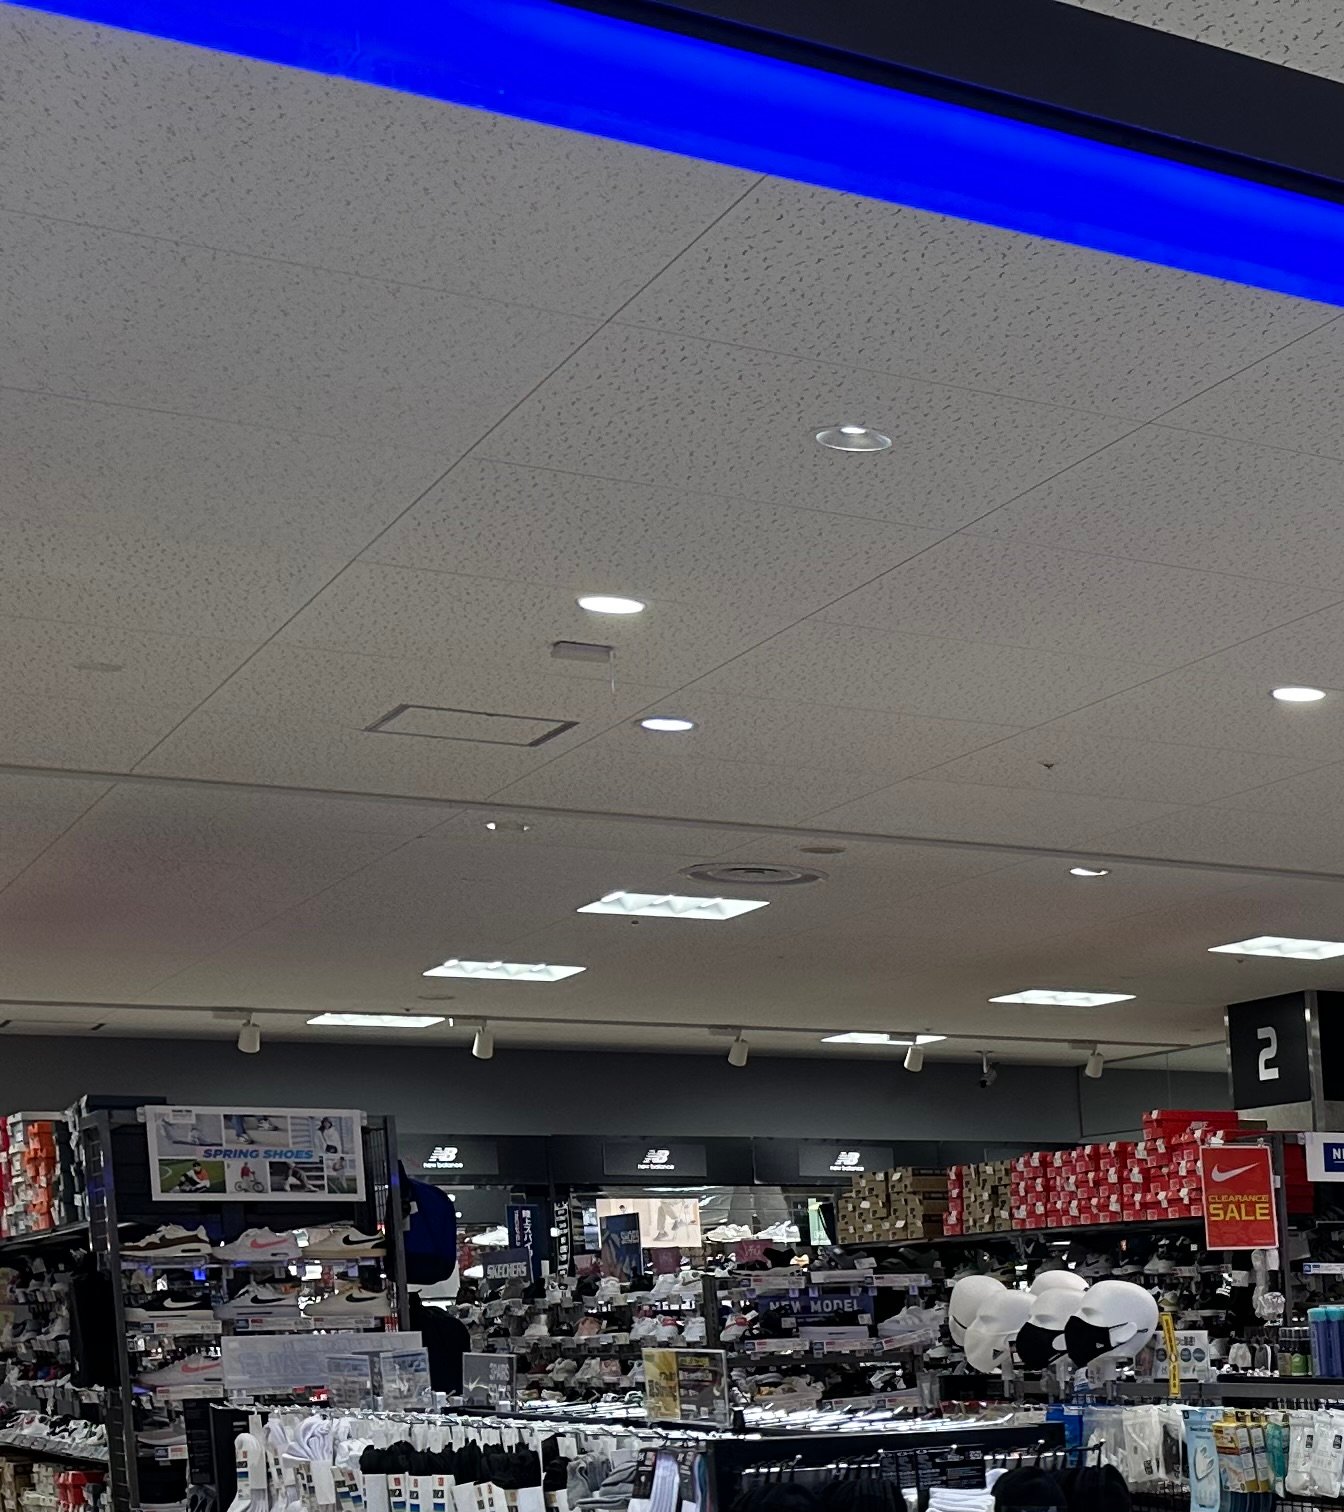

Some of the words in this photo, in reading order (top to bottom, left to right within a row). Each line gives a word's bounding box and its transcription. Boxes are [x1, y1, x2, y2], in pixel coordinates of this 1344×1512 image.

[1256, 1027, 1279, 1080] 2
[203, 1148, 260, 1159] SPRING
[262, 1149, 313, 1160] SHOES
[1208, 1194, 1269, 1202] CLEARANCE
[1209, 1203, 1270, 1221] SALE
[486, 1262, 527, 1279] SKECHERS
